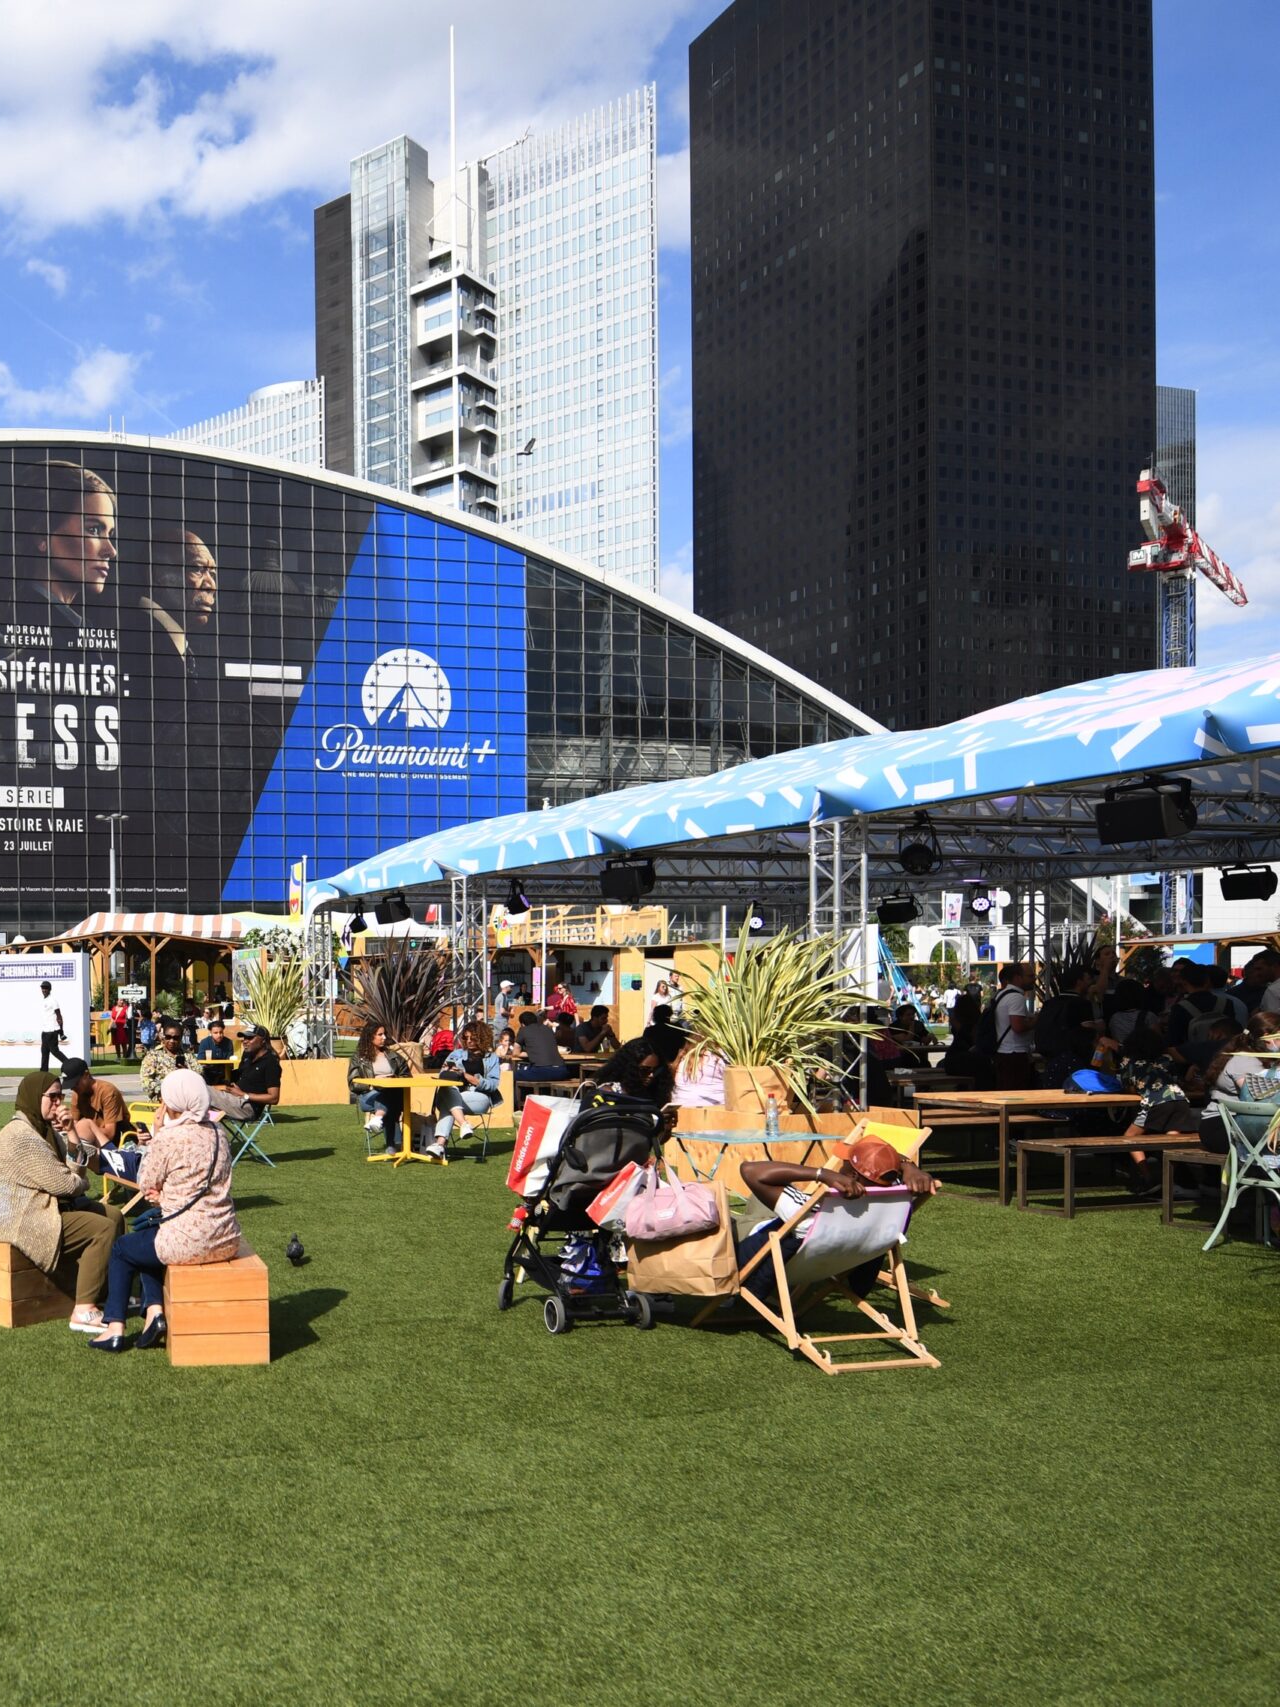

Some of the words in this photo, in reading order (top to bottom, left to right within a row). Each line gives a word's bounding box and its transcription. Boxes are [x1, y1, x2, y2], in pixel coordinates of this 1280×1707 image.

[6, 625, 51, 636] MORGAN
[78, 628, 116, 639] NICOLE
[3, 635, 53, 647] FREEMAN
[77, 638, 118, 649] KIDMAN
[315, 723, 496, 771] Paramount+
[6, 786, 53, 805] SÉRIE
[47, 818, 84, 833] VRAIE
[3, 840, 15, 851] 23
[18, 841, 53, 852] JUILLET
[514, 1126, 534, 1173] idkids.com
